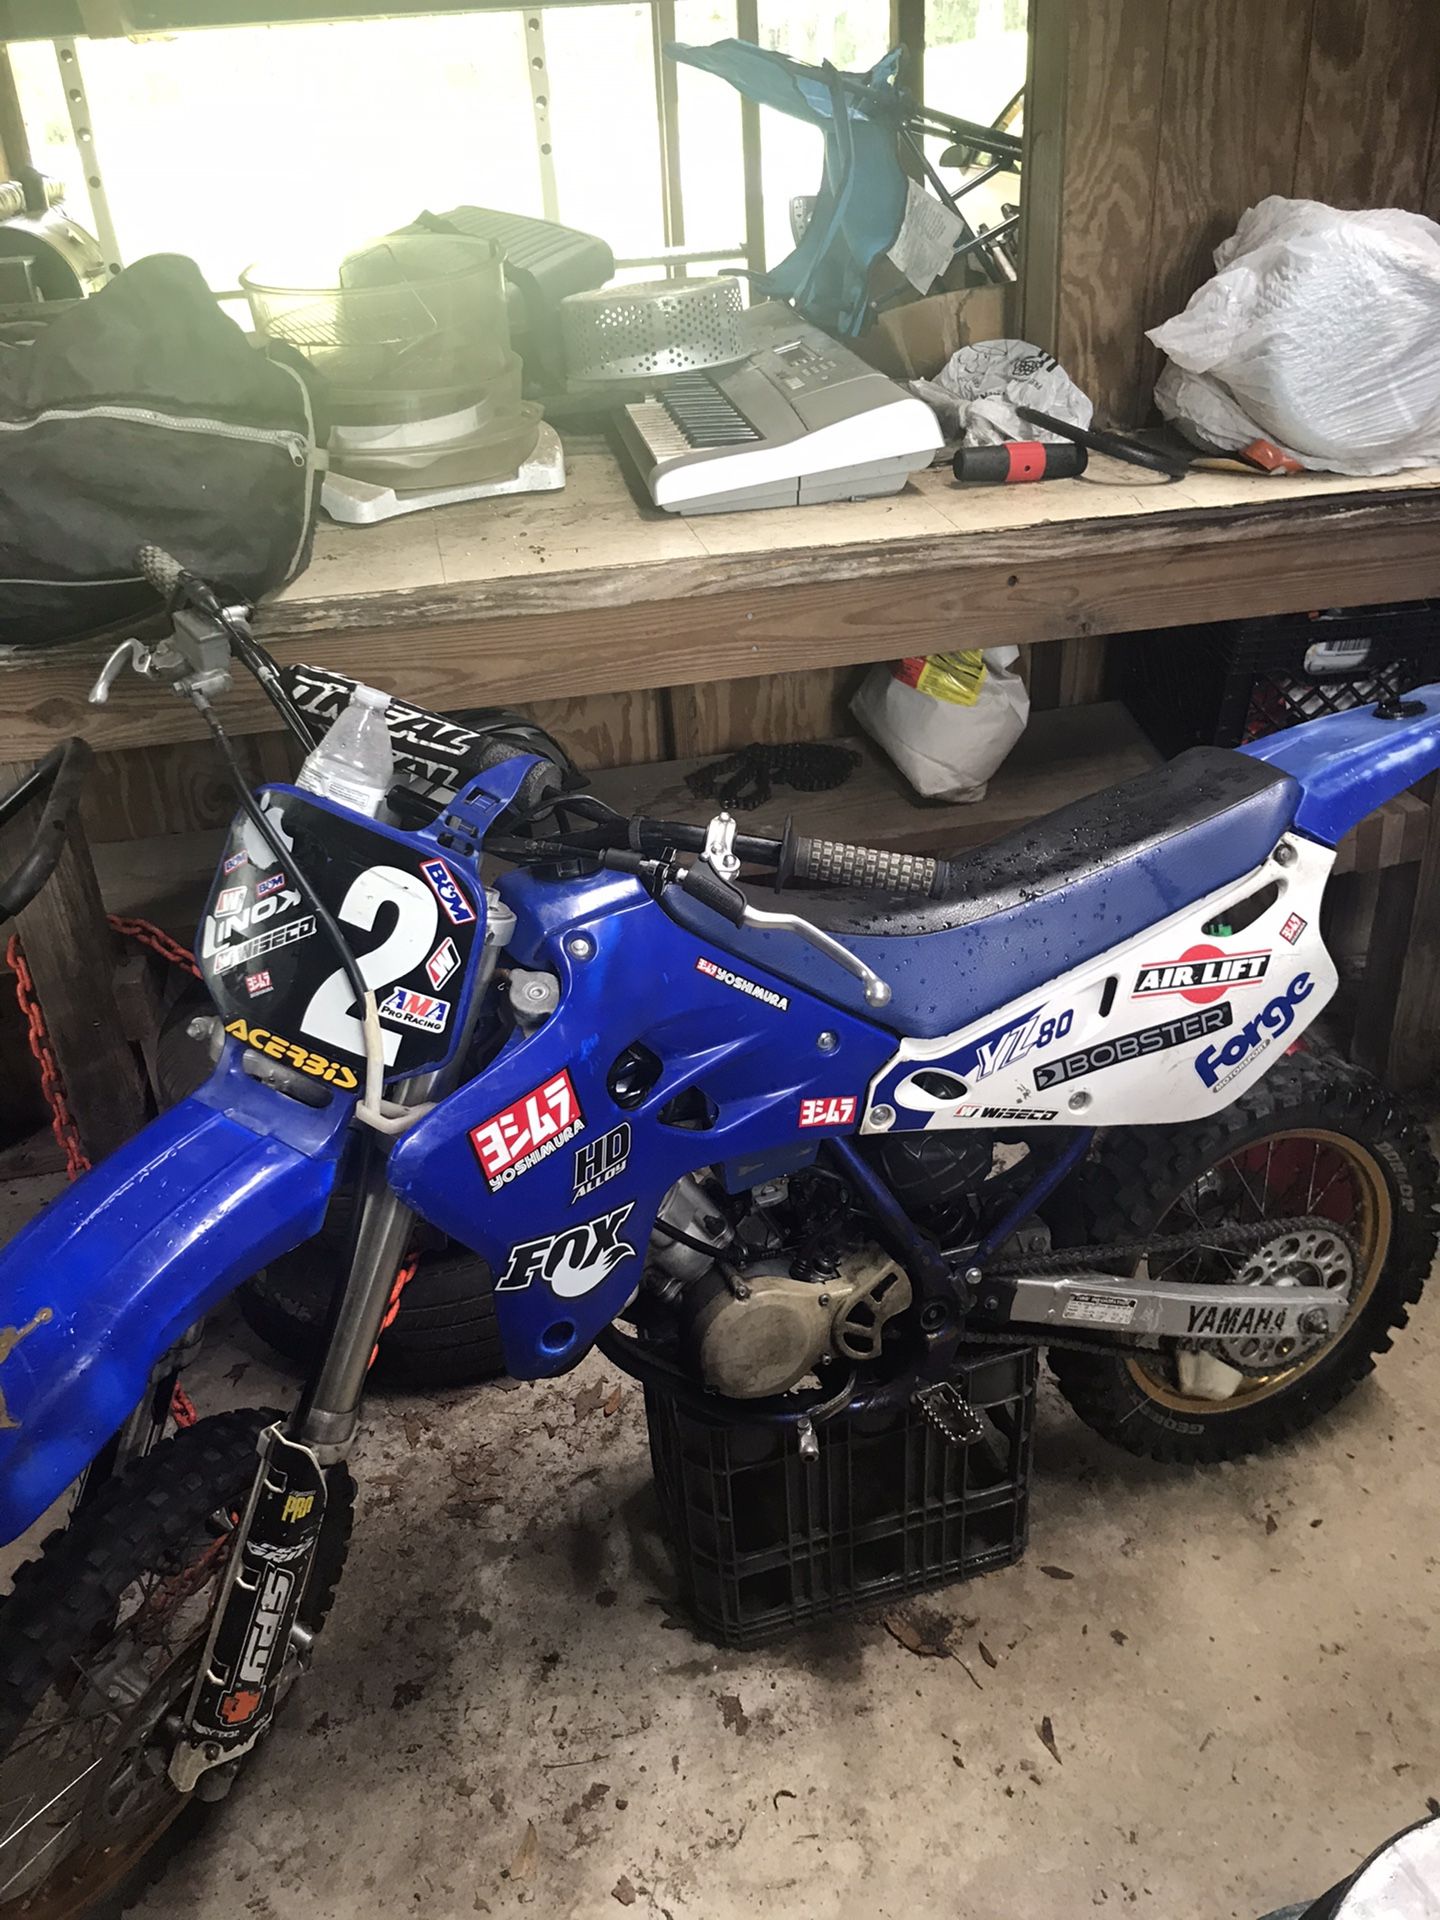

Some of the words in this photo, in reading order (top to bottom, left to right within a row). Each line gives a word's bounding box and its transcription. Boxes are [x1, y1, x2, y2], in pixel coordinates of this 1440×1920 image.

[426, 863, 472, 922] B&M
[300, 866, 438, 1067] 2
[715, 967, 789, 1011] YOSHIMURA
[1138, 967, 1195, 991] AIR
[1201, 957, 1266, 984] LIFT
[385, 990, 448, 1022] AMA
[1065, 1007, 1225, 1077] BOBSTER
[1215, 1040, 1269, 1092] MOTORSPORT
[475, 1077, 573, 1173] ヨシムラ
[801, 1098, 856, 1125] ヨシムラ
[488, 1118, 585, 1193] YOSHIMURA
[573, 1121, 631, 1191] HD
[495, 1201, 636, 1297] FOX
[240, 1568, 289, 1682] SPY
